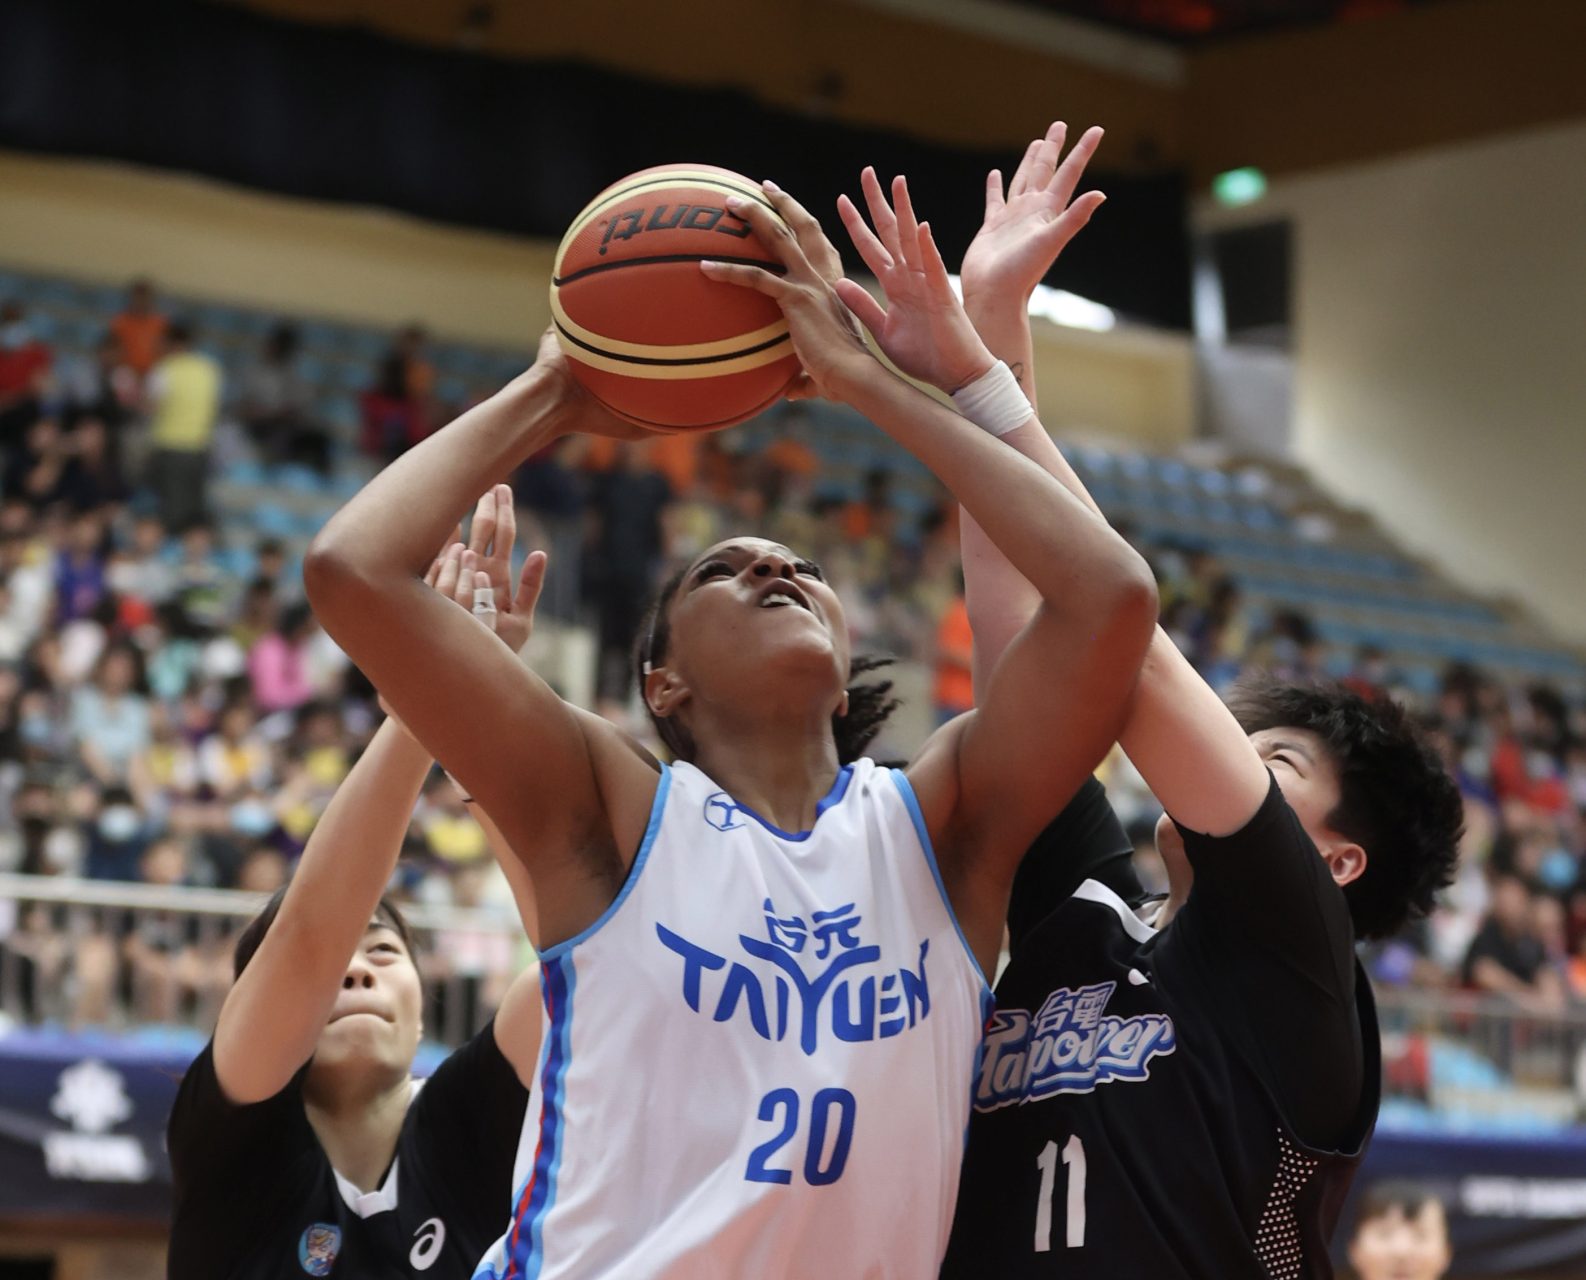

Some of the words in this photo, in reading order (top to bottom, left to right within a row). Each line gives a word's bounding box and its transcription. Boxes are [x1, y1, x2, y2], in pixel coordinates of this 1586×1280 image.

[598, 205, 751, 255] conti
[656, 922, 930, 1056] TAIYUEN
[1035, 988, 1107, 1037] 台電
[744, 1087, 857, 1186] 20
[1034, 1134, 1087, 1252] 11
